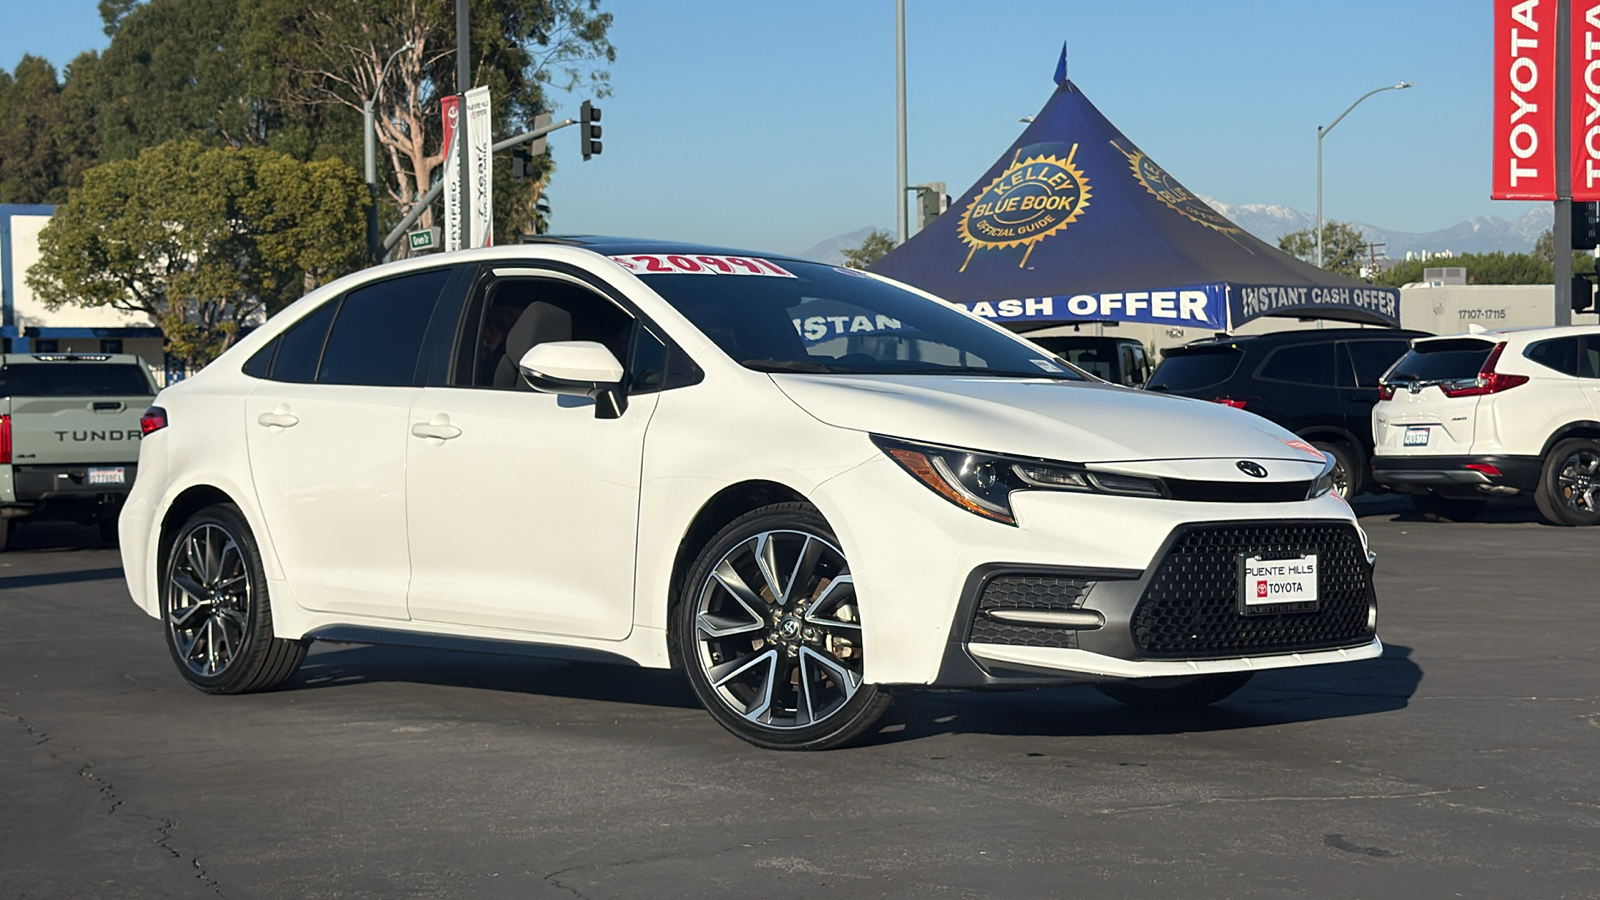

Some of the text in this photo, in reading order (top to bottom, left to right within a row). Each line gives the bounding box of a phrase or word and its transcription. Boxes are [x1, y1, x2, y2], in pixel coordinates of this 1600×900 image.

[1509, 0, 1539, 187] TOYOTA
[993, 166, 1074, 195] KELLEY
[972, 195, 1076, 219] BLUE BOOK
[976, 214, 1056, 238] OFFICIAL GUIDE
[1067, 290, 1208, 321] OFFER
[1241, 287, 1396, 318] INSTANT CASH OFFER
[54, 430, 142, 442] TUNDR
[1245, 564, 1314, 577] PUENTE HILLS
[1268, 581, 1303, 594] TOYOTA
